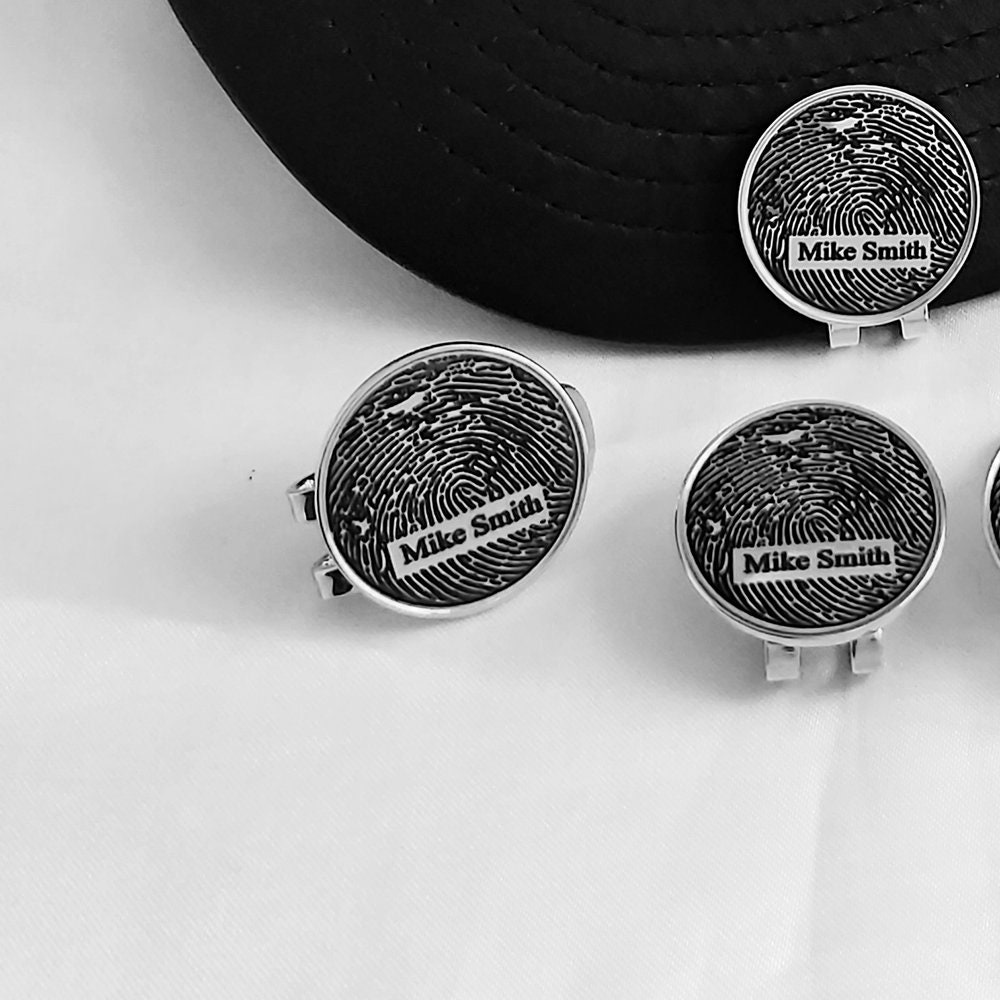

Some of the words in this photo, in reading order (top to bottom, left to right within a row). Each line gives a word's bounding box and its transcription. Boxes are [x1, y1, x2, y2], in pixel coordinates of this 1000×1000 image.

[797, 240, 857, 261] Mike
[862, 239, 927, 261] Smith
[399, 528, 467, 565] Mike
[471, 494, 544, 538] Smith
[743, 551, 810, 574] Mike
[816, 546, 891, 569] Smith
